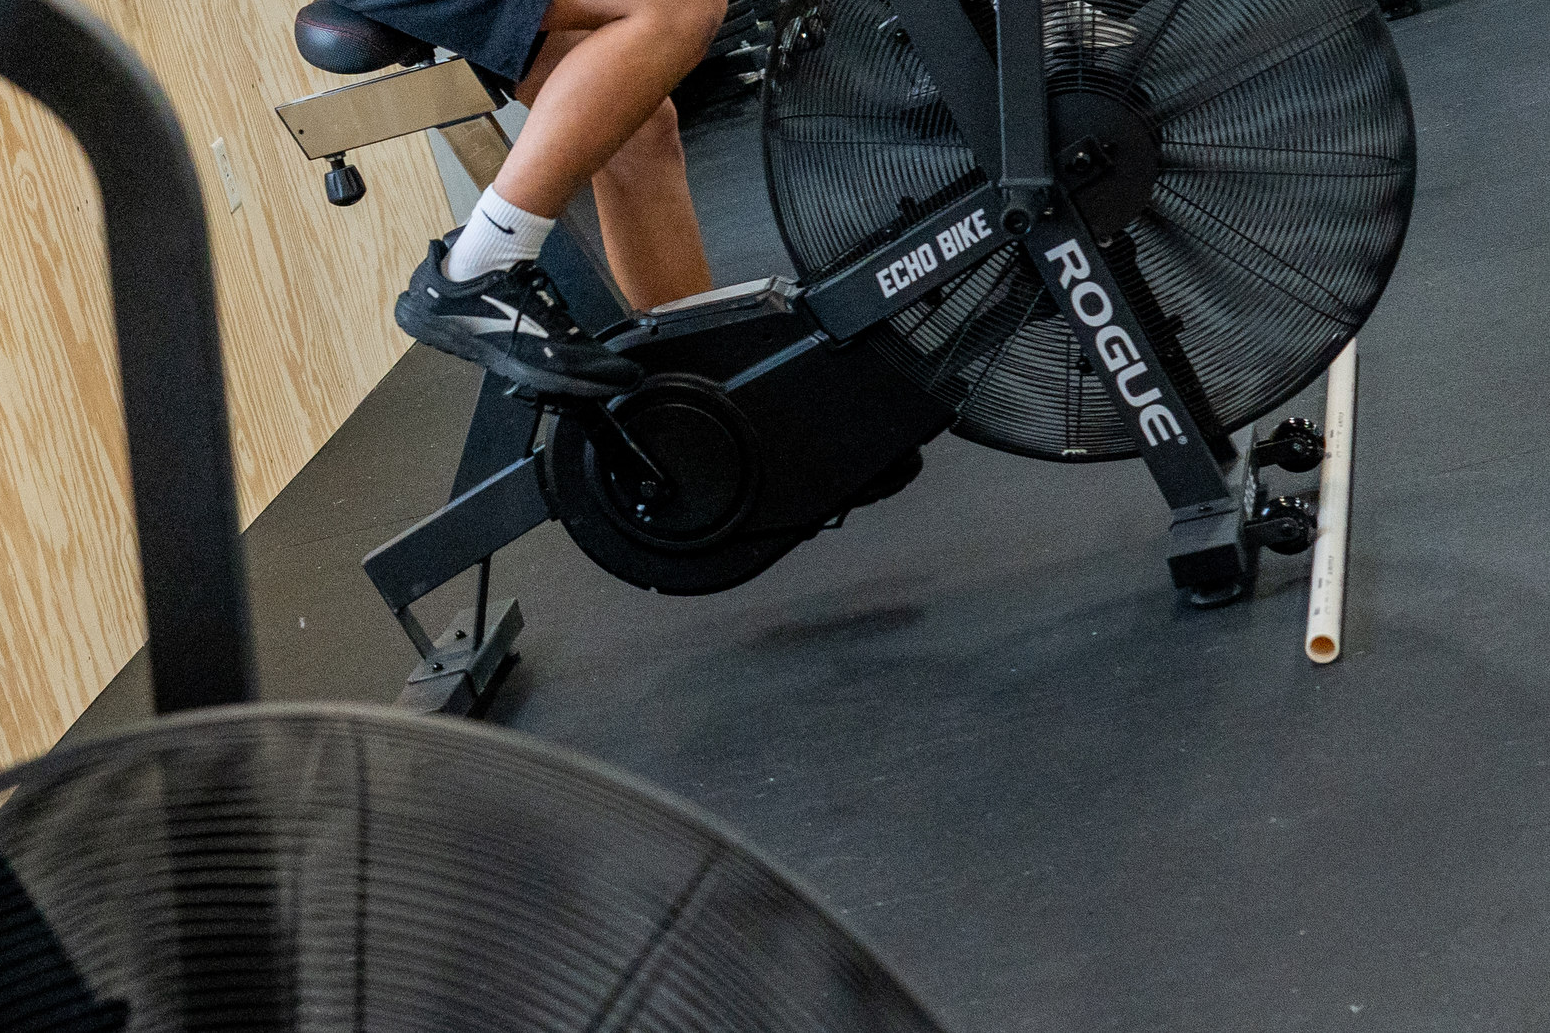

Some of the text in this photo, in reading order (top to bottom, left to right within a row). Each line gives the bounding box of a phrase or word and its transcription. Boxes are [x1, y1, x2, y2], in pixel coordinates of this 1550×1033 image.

[875, 208, 993, 298] ECHO BIKE
[1044, 238, 1183, 447] ROGUE
